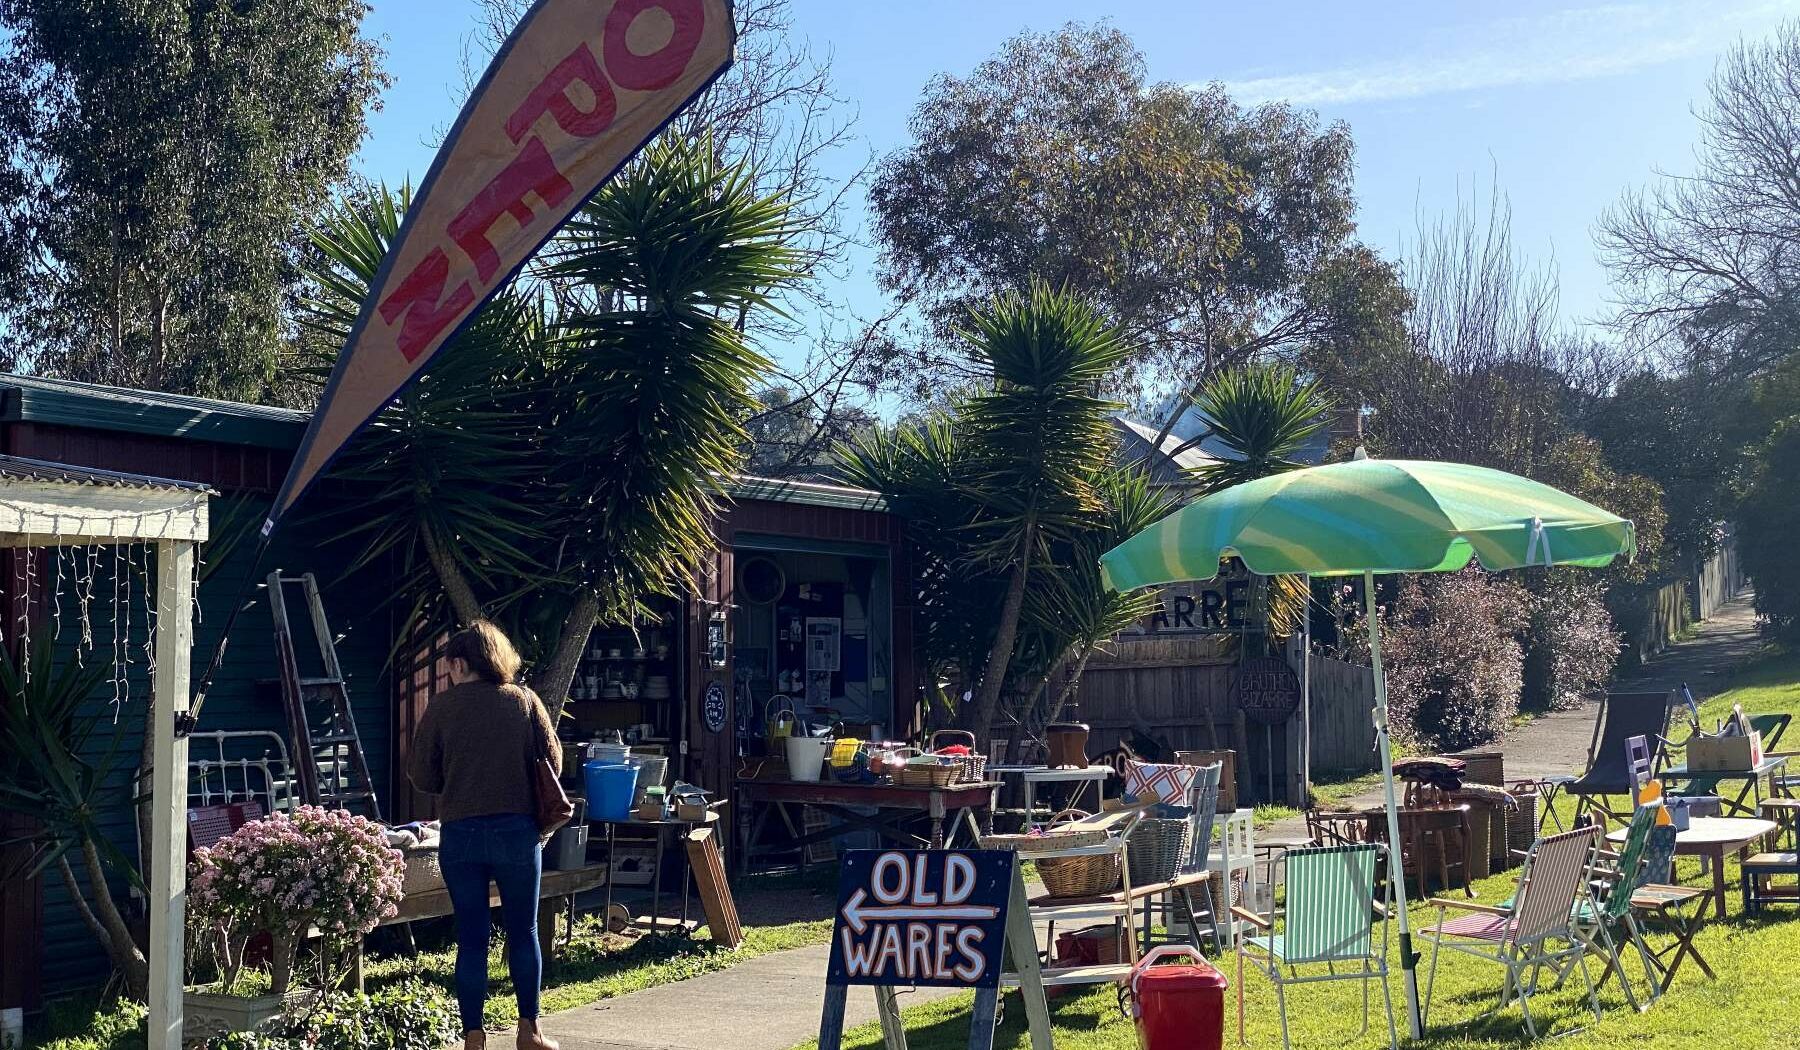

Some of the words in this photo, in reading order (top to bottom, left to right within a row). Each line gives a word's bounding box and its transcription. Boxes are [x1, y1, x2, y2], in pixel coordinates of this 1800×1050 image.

[378, 0, 705, 364] OPEN
[871, 851, 977, 905] OLD
[841, 922, 986, 983] WARES
